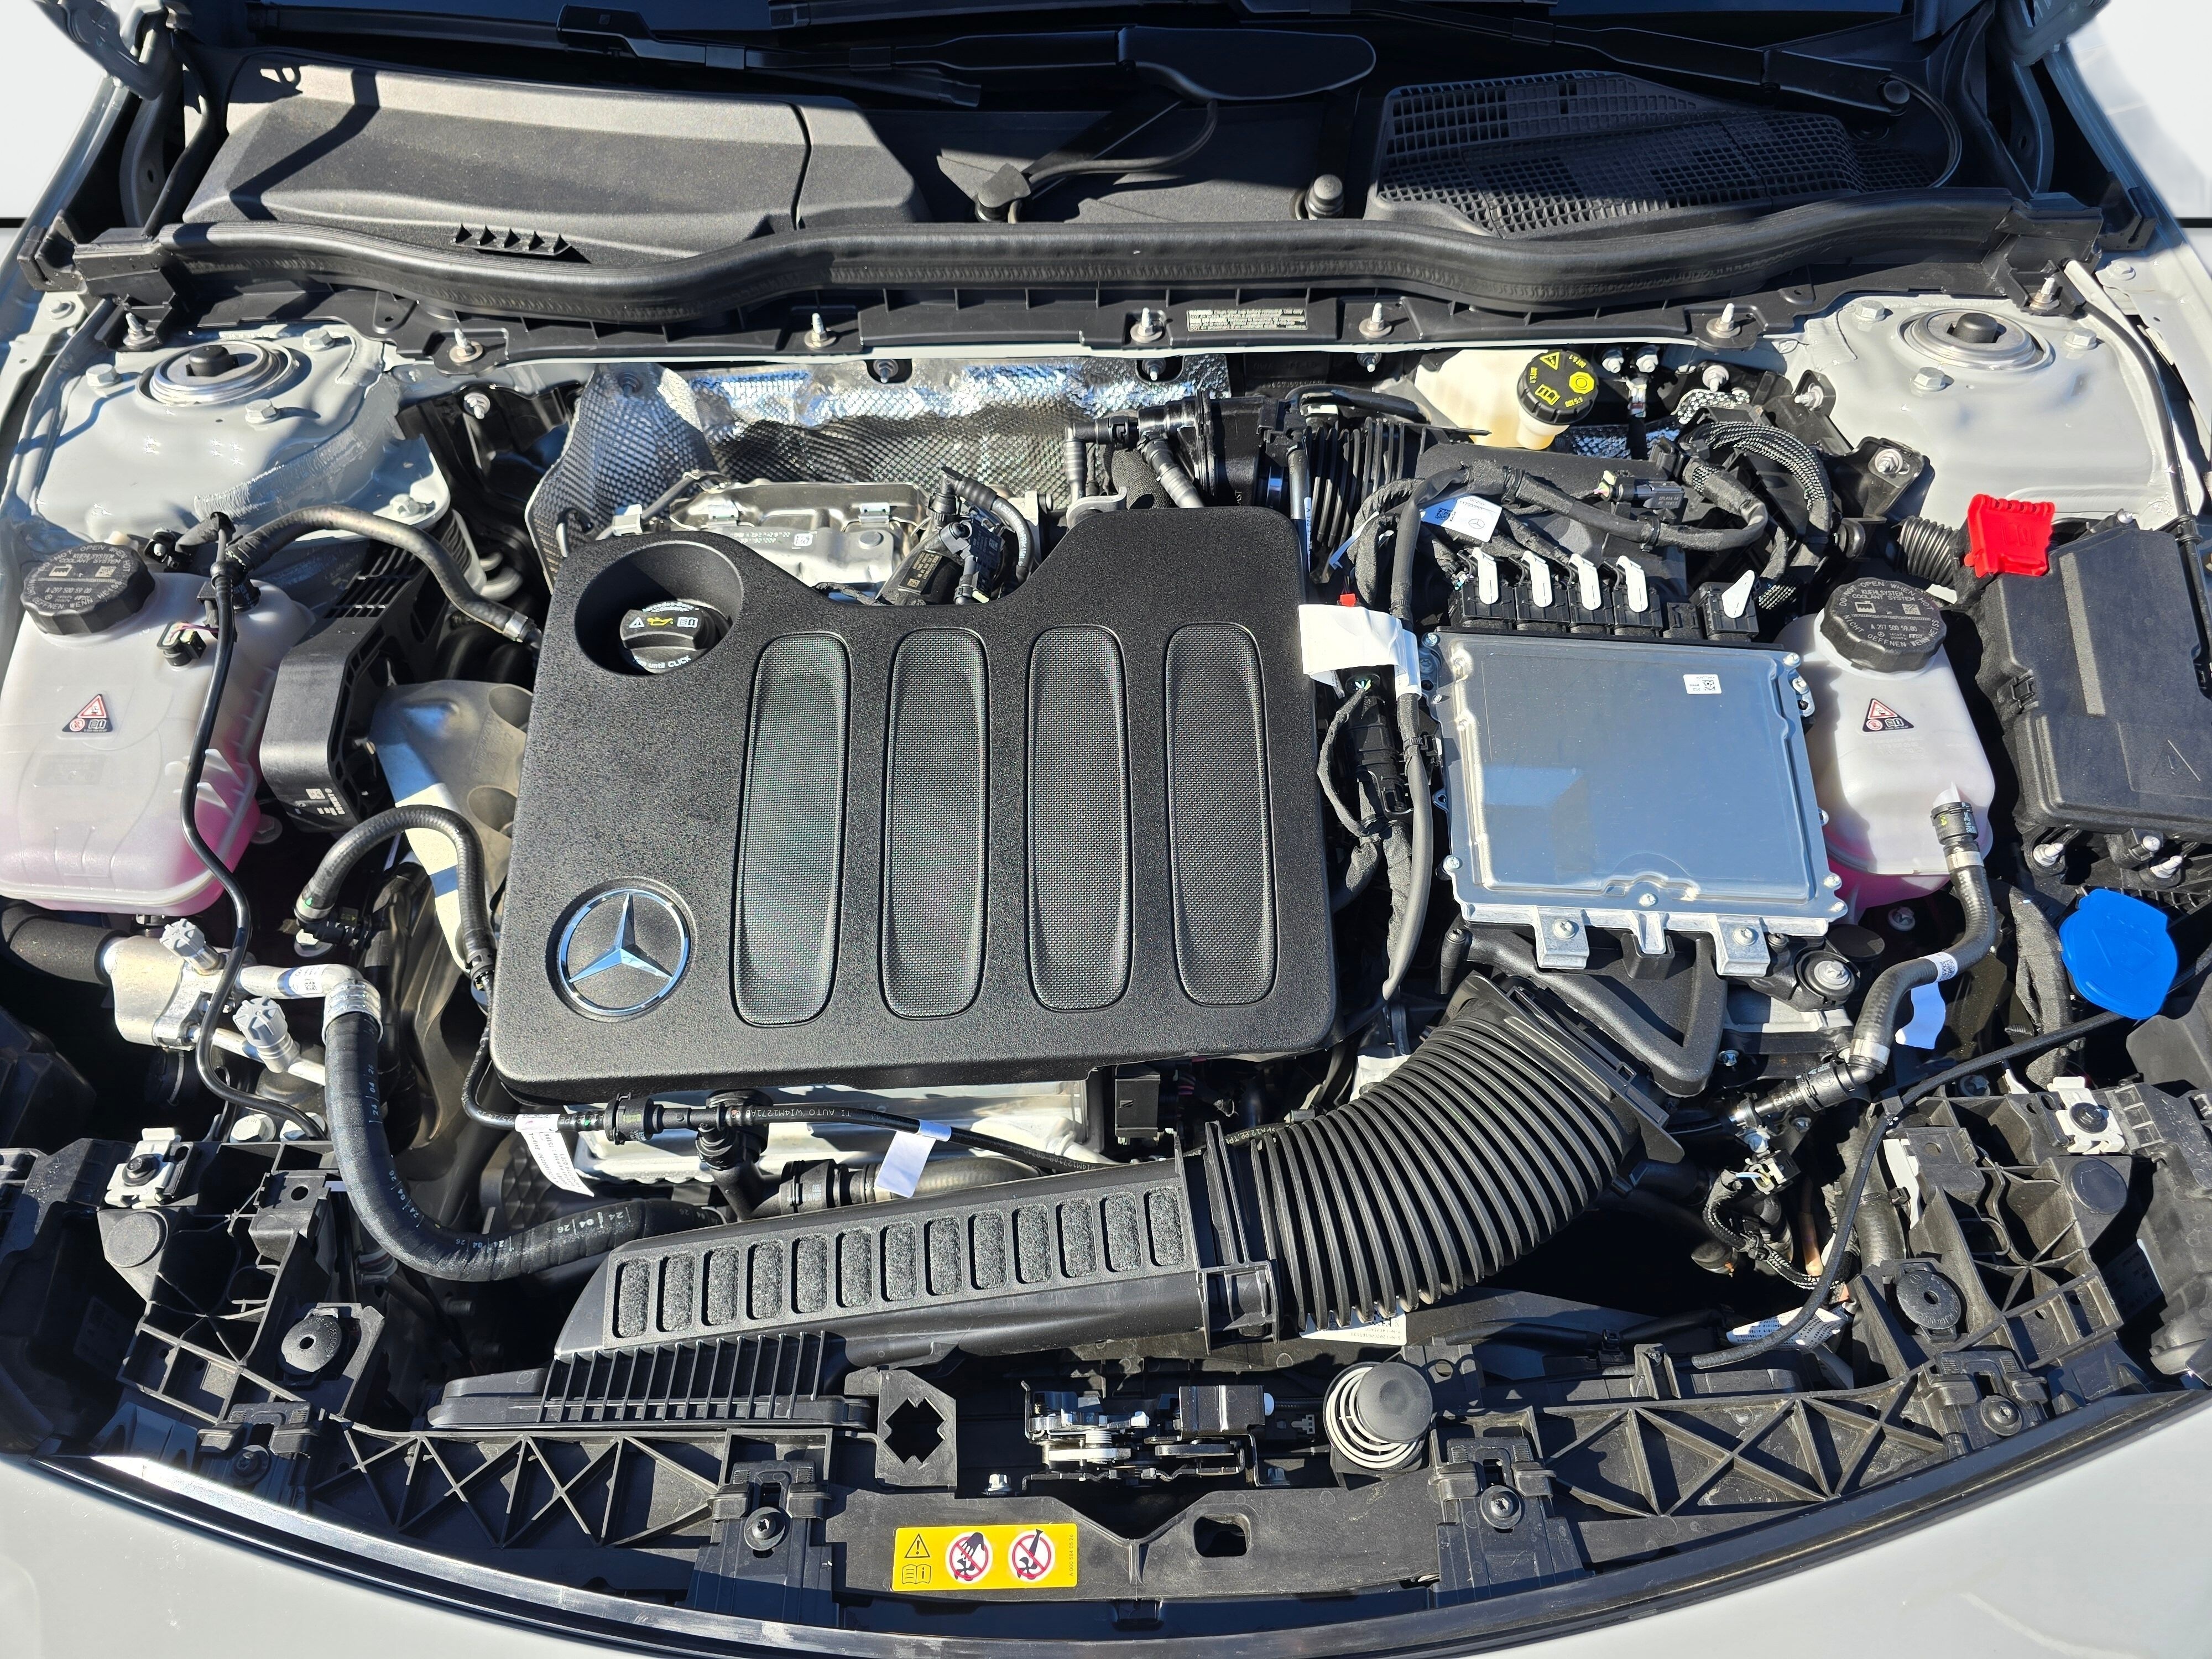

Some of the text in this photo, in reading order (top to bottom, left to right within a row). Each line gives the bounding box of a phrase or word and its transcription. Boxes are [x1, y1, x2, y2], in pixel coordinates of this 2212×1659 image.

[109, 547, 127, 559] WHEN
[70, 598, 93, 608] WENN
[1839, 598, 1848, 607] DO
[1844, 586, 1857, 597] NOT
[1891, 583, 1916, 597] WHEN
[1918, 597, 1934, 611] HOT
[1843, 614, 1865, 633] NICHT
[1867, 634, 1906, 647] OEFFNEN
[1928, 619, 1939, 637] HEISS
[667, 655, 692, 667] CLICK
[368, 1064, 379, 1116] 24 04 26
[389, 1170, 419, 1218] 24 04 26
[556, 1211, 624, 1233] 24 04 26
[493, 1240, 504, 1248] 24
